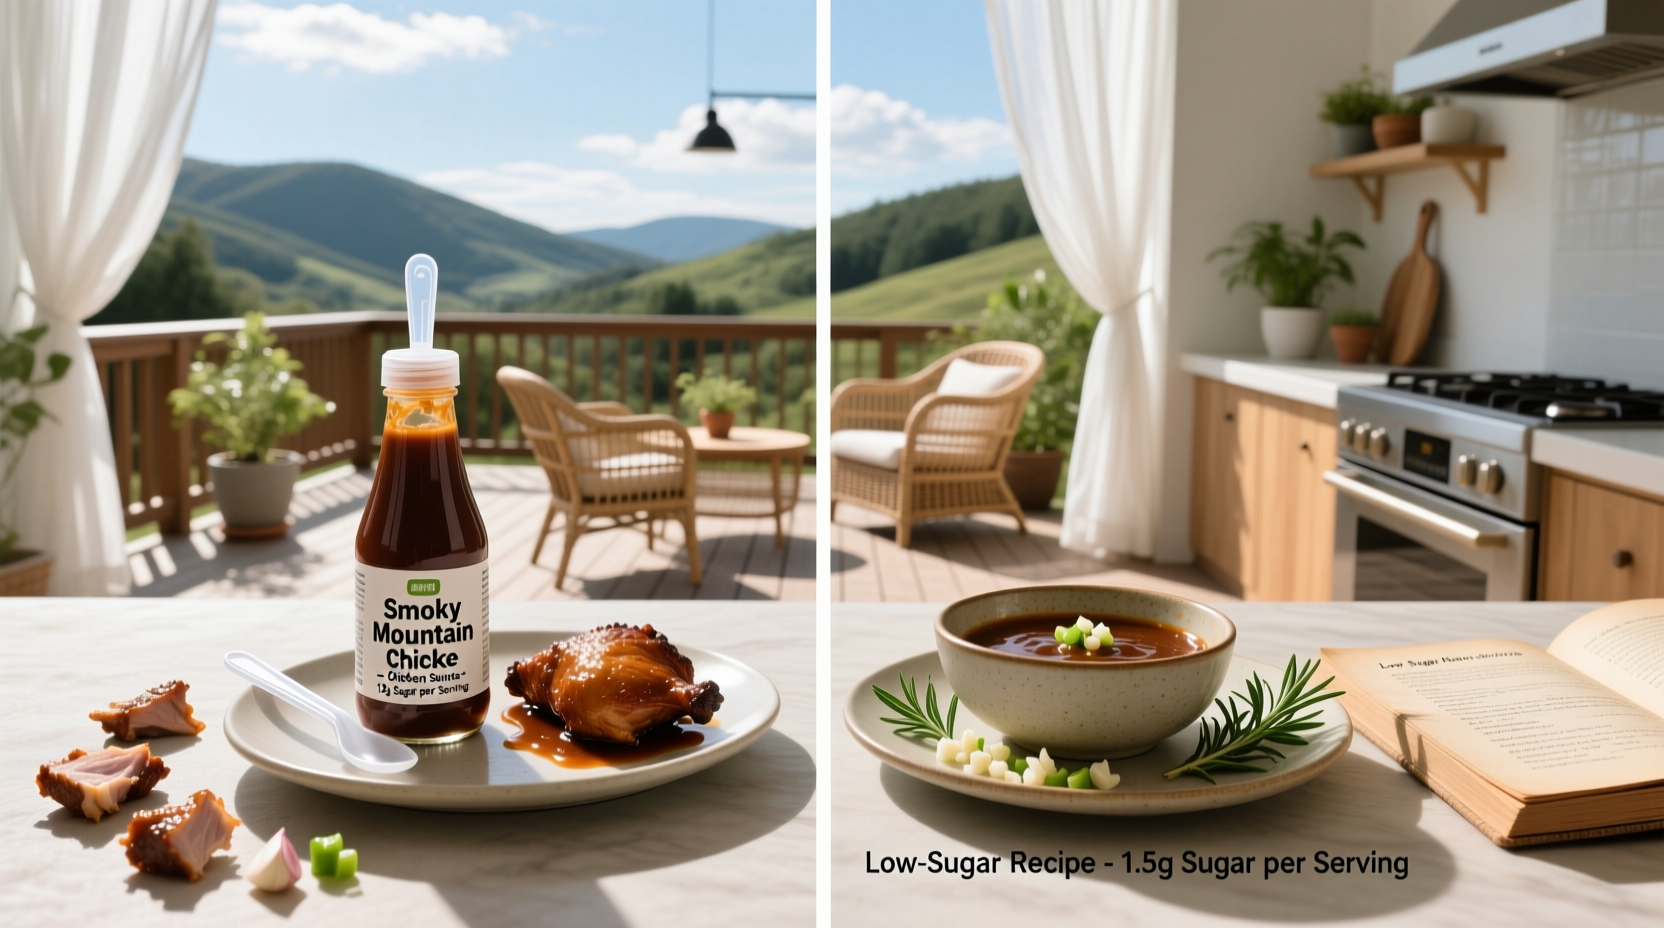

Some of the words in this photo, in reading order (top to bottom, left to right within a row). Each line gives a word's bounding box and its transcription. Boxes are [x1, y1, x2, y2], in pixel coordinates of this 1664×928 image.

[384, 598, 461, 623] Smoky
[373, 621, 473, 645] Mountain
[386, 648, 459, 669] Chicke
[420, 687, 436, 698] per
